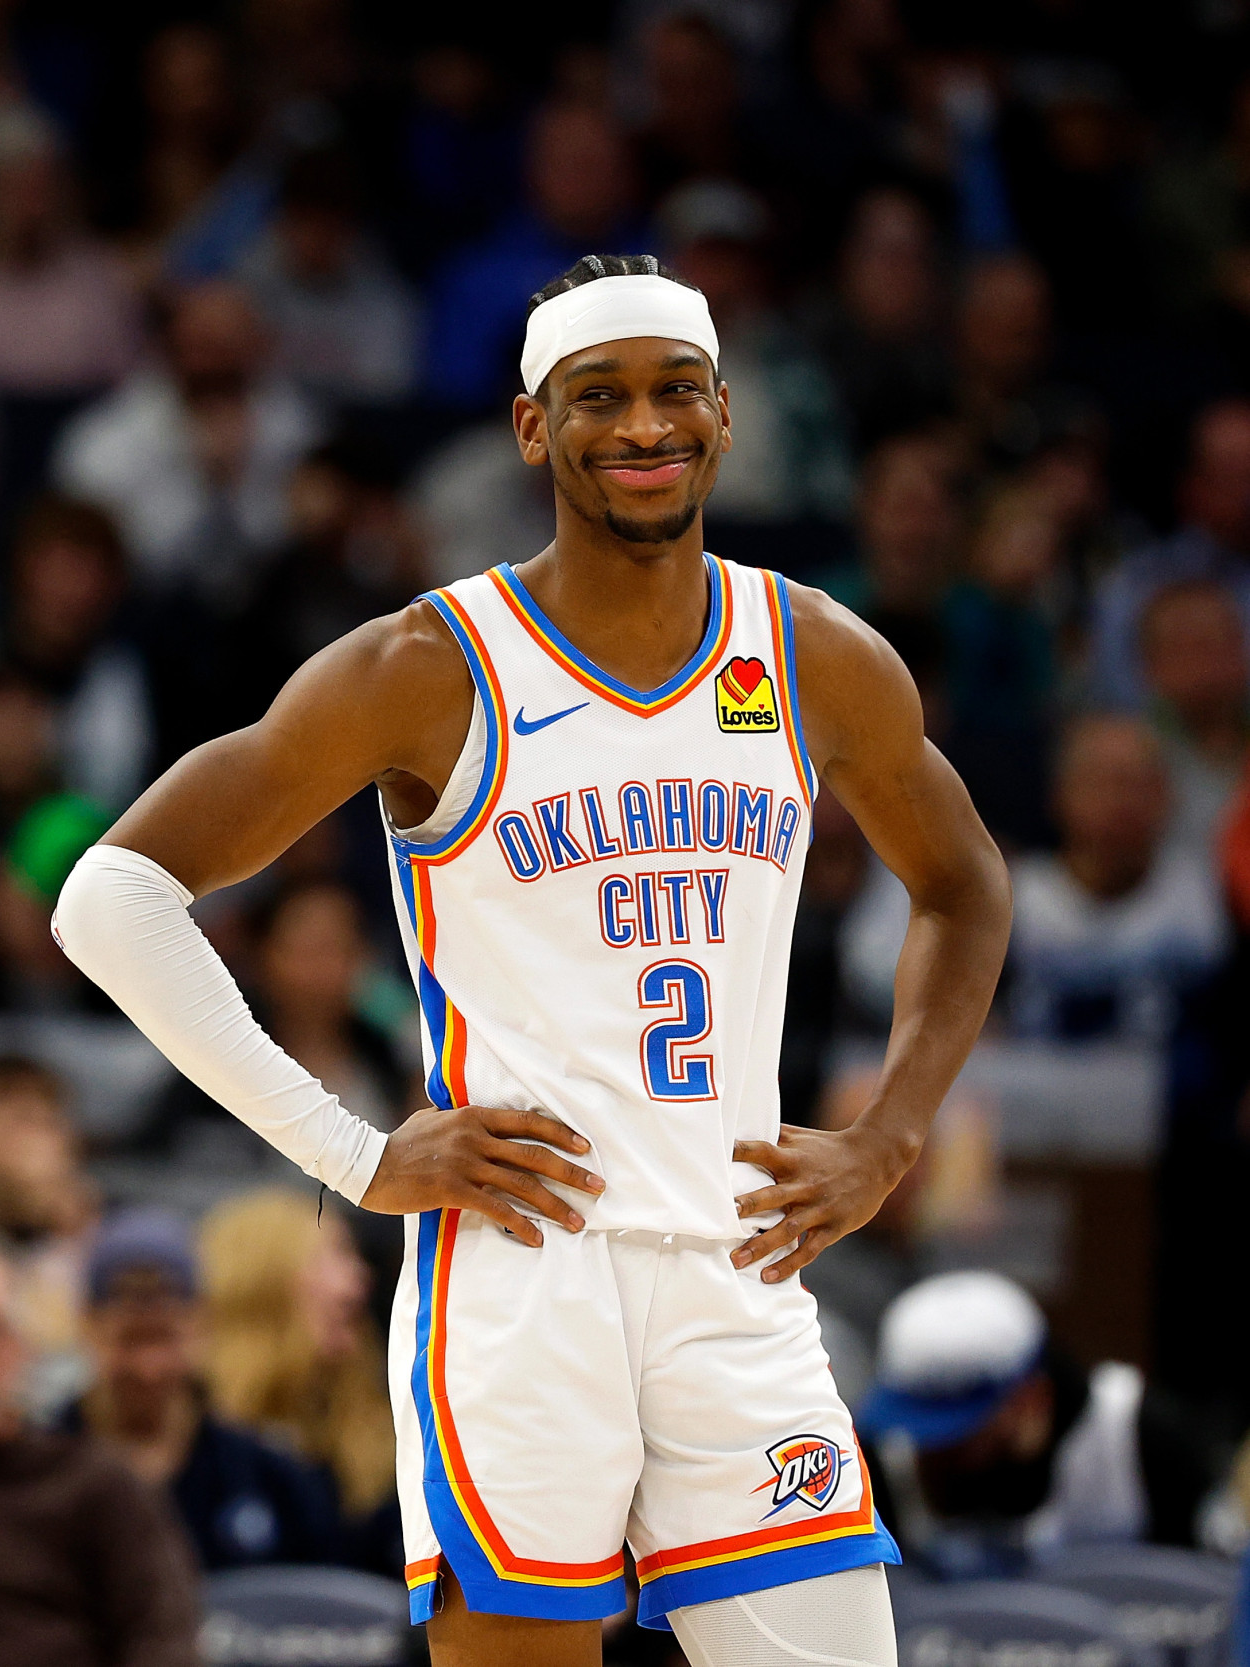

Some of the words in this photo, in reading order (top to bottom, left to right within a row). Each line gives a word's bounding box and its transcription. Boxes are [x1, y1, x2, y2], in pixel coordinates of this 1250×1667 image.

[493, 778, 801, 884] OKLAHOMA
[598, 868, 730, 949] CITY
[637, 957, 719, 1102] 2
[774, 1446, 829, 1502] OKC
